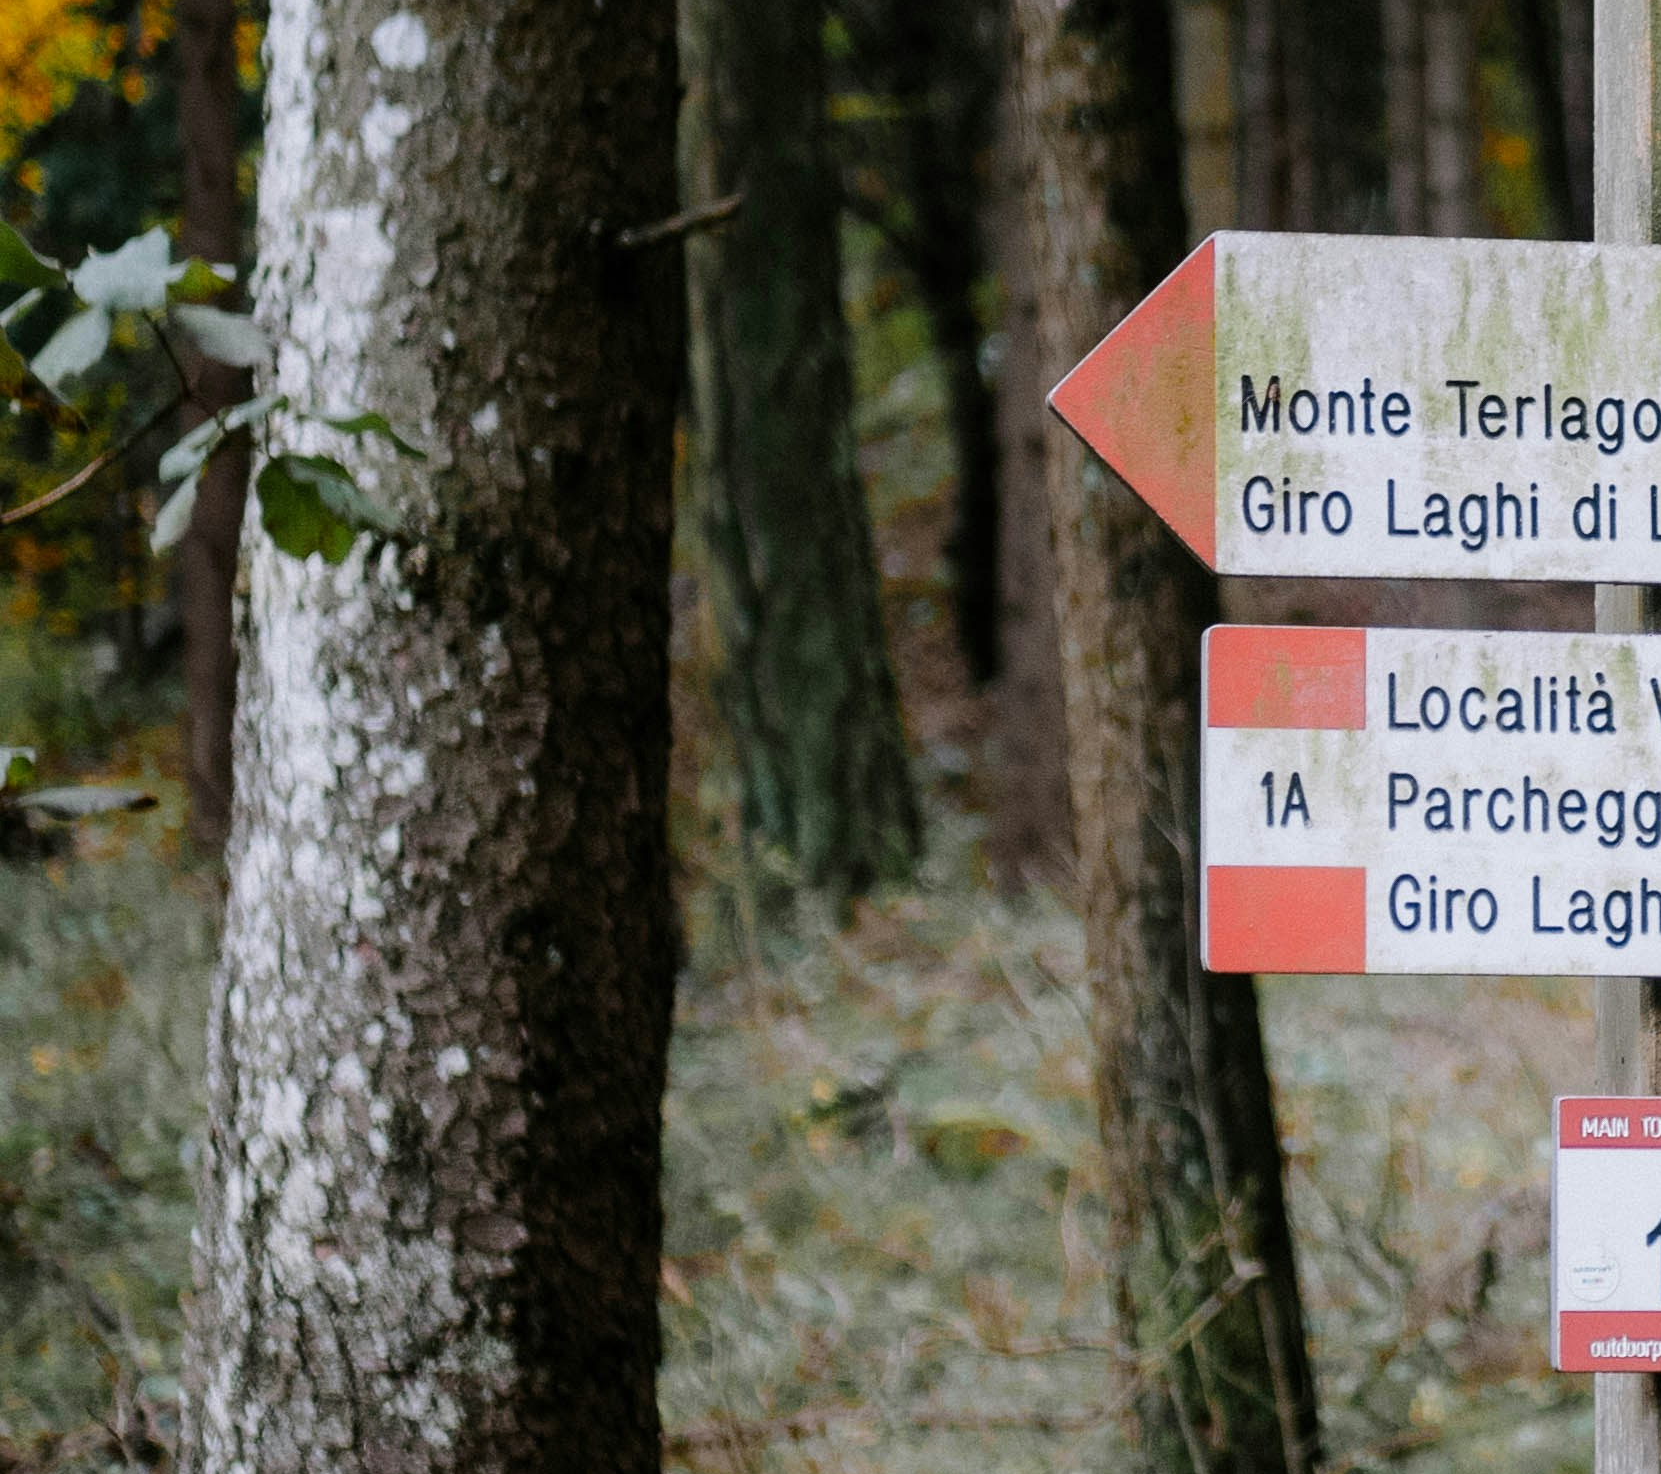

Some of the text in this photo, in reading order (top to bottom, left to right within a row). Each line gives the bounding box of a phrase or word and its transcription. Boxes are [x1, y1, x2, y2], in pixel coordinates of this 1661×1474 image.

[1239, 373, 1412, 438] Monte
[1241, 474, 1353, 537] Giro
[1386, 477, 1540, 554] Laghi
[1571, 481, 1618, 542] di
[1387, 671, 1618, 735] Località
[1260, 770, 1311, 827] 1A
[1388, 872, 1499, 934] Giro
[1581, 1116, 1630, 1138] MAIN
